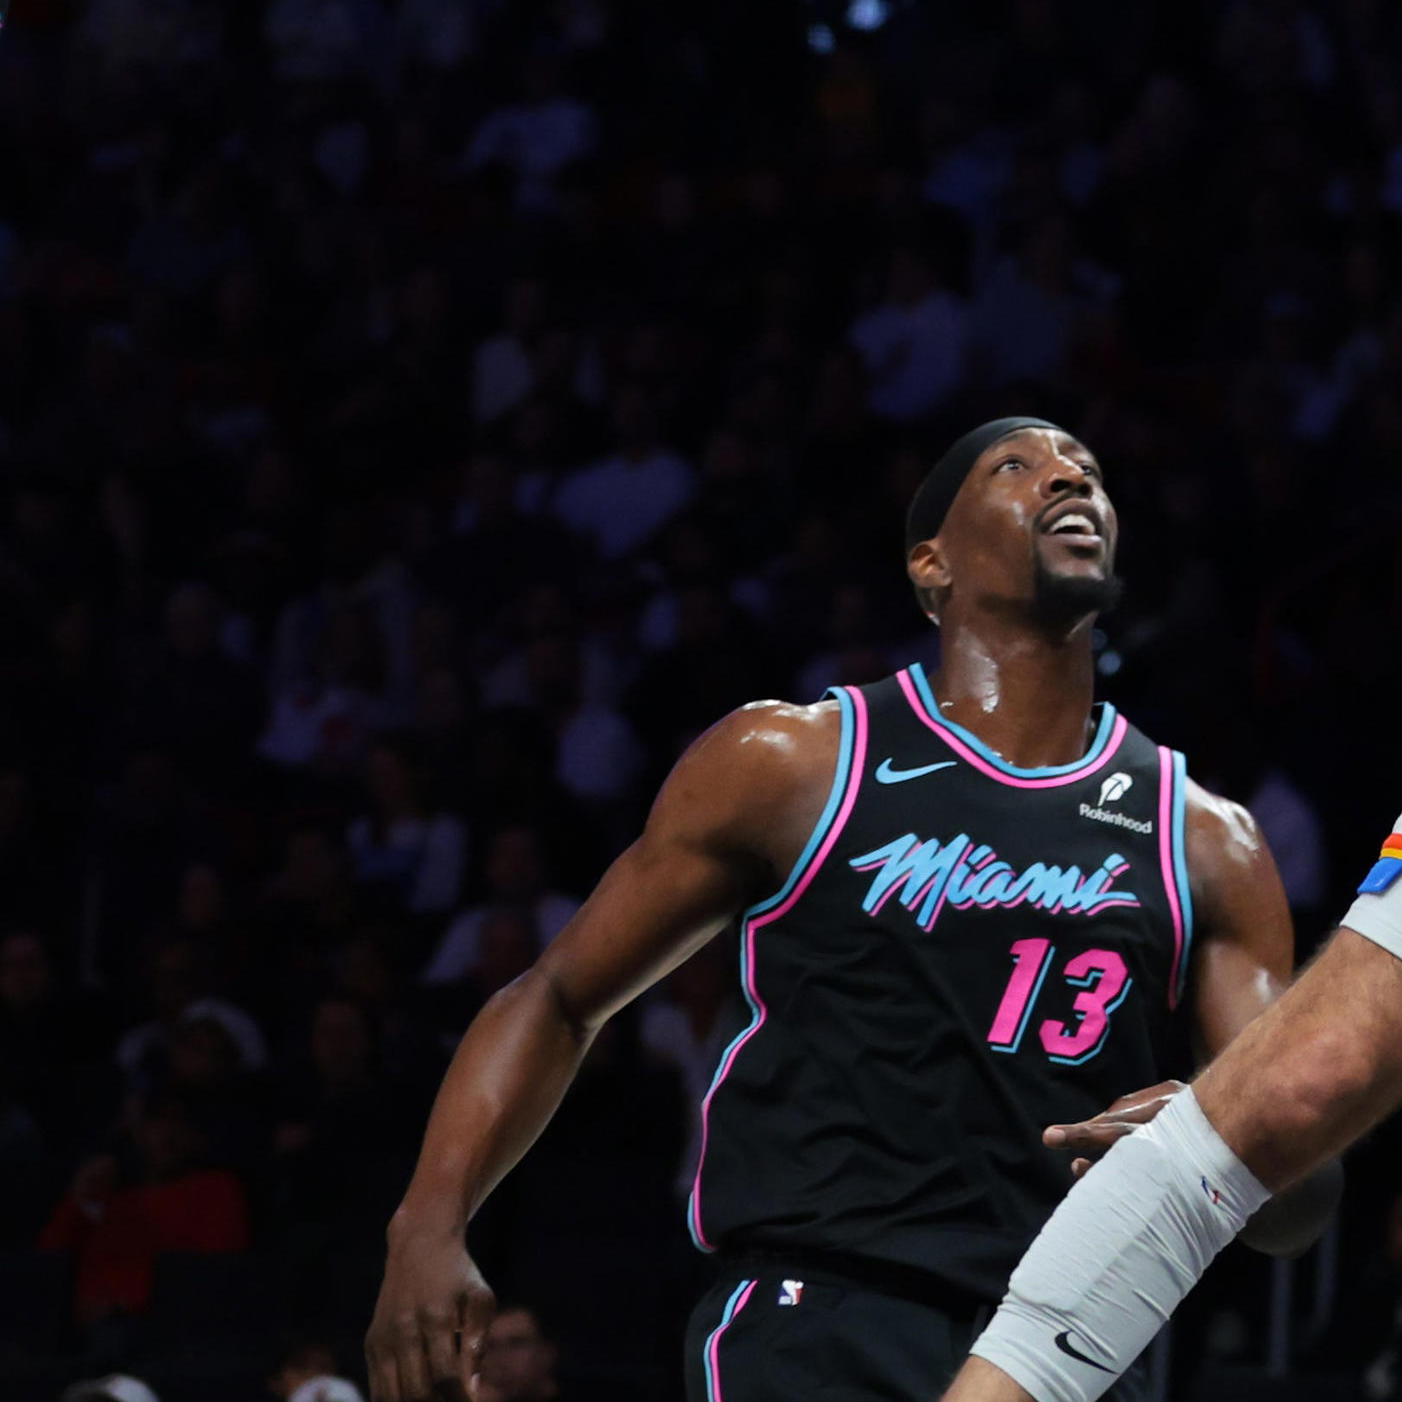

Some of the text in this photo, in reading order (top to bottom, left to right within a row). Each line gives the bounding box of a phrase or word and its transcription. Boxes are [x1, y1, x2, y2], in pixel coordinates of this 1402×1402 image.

[1079, 802, 1152, 834] Robinhood
[848, 832, 1141, 933] Miami
[986, 938, 1133, 1066] 13
